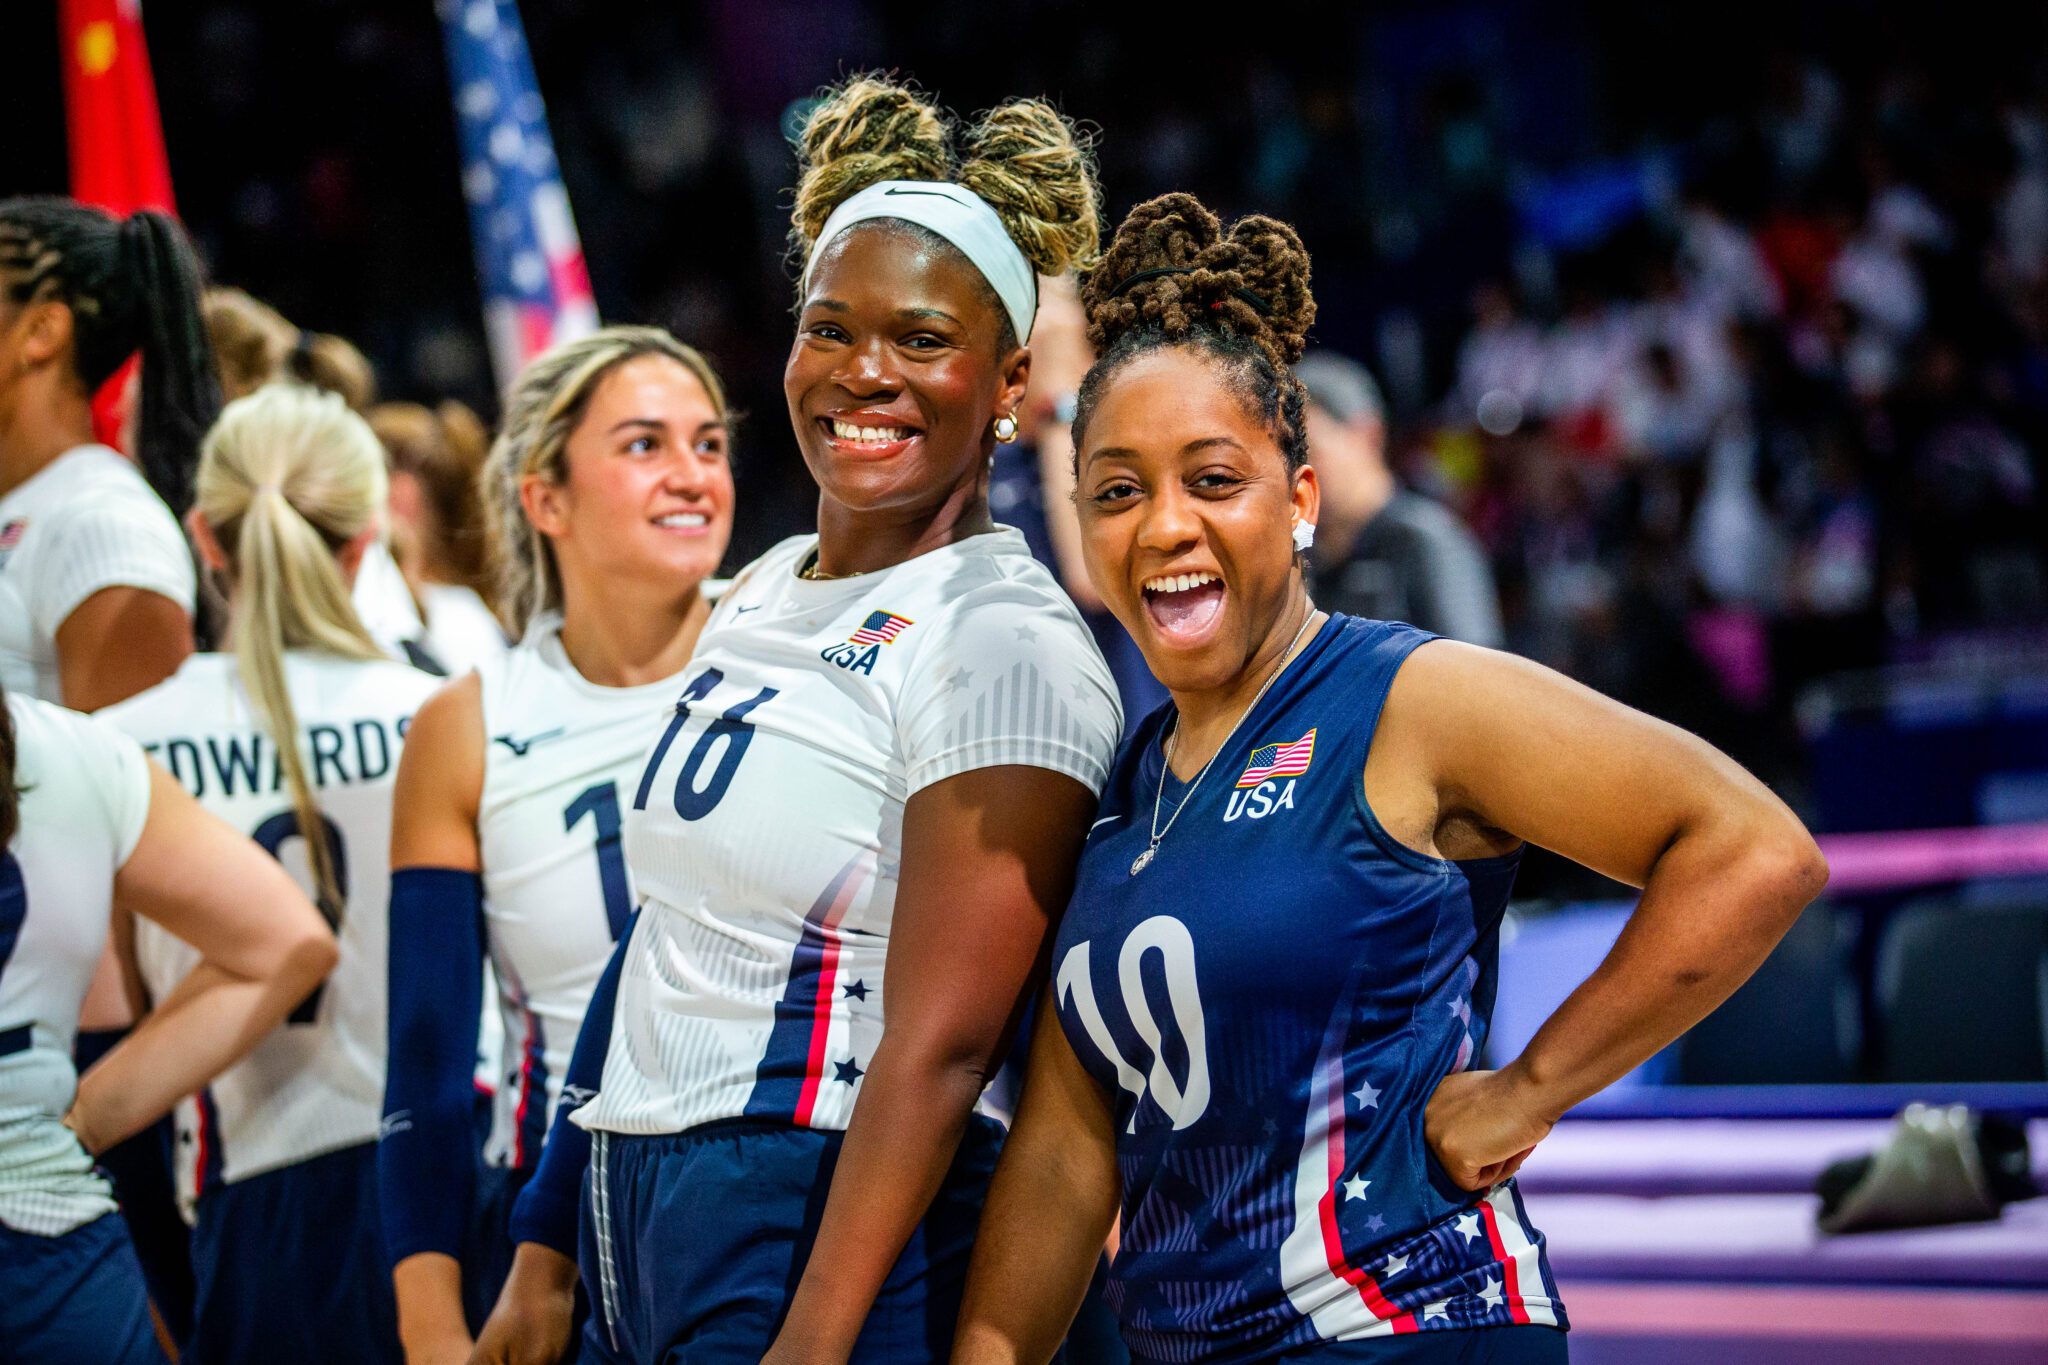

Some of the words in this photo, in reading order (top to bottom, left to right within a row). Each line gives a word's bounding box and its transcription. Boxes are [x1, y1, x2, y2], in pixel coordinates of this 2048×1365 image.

[820, 642, 880, 676] USA
[143, 717, 413, 798] DWRD
[633, 666, 781, 822] 16
[1223, 778, 1297, 823] USA
[1056, 914, 1211, 1135] 10
